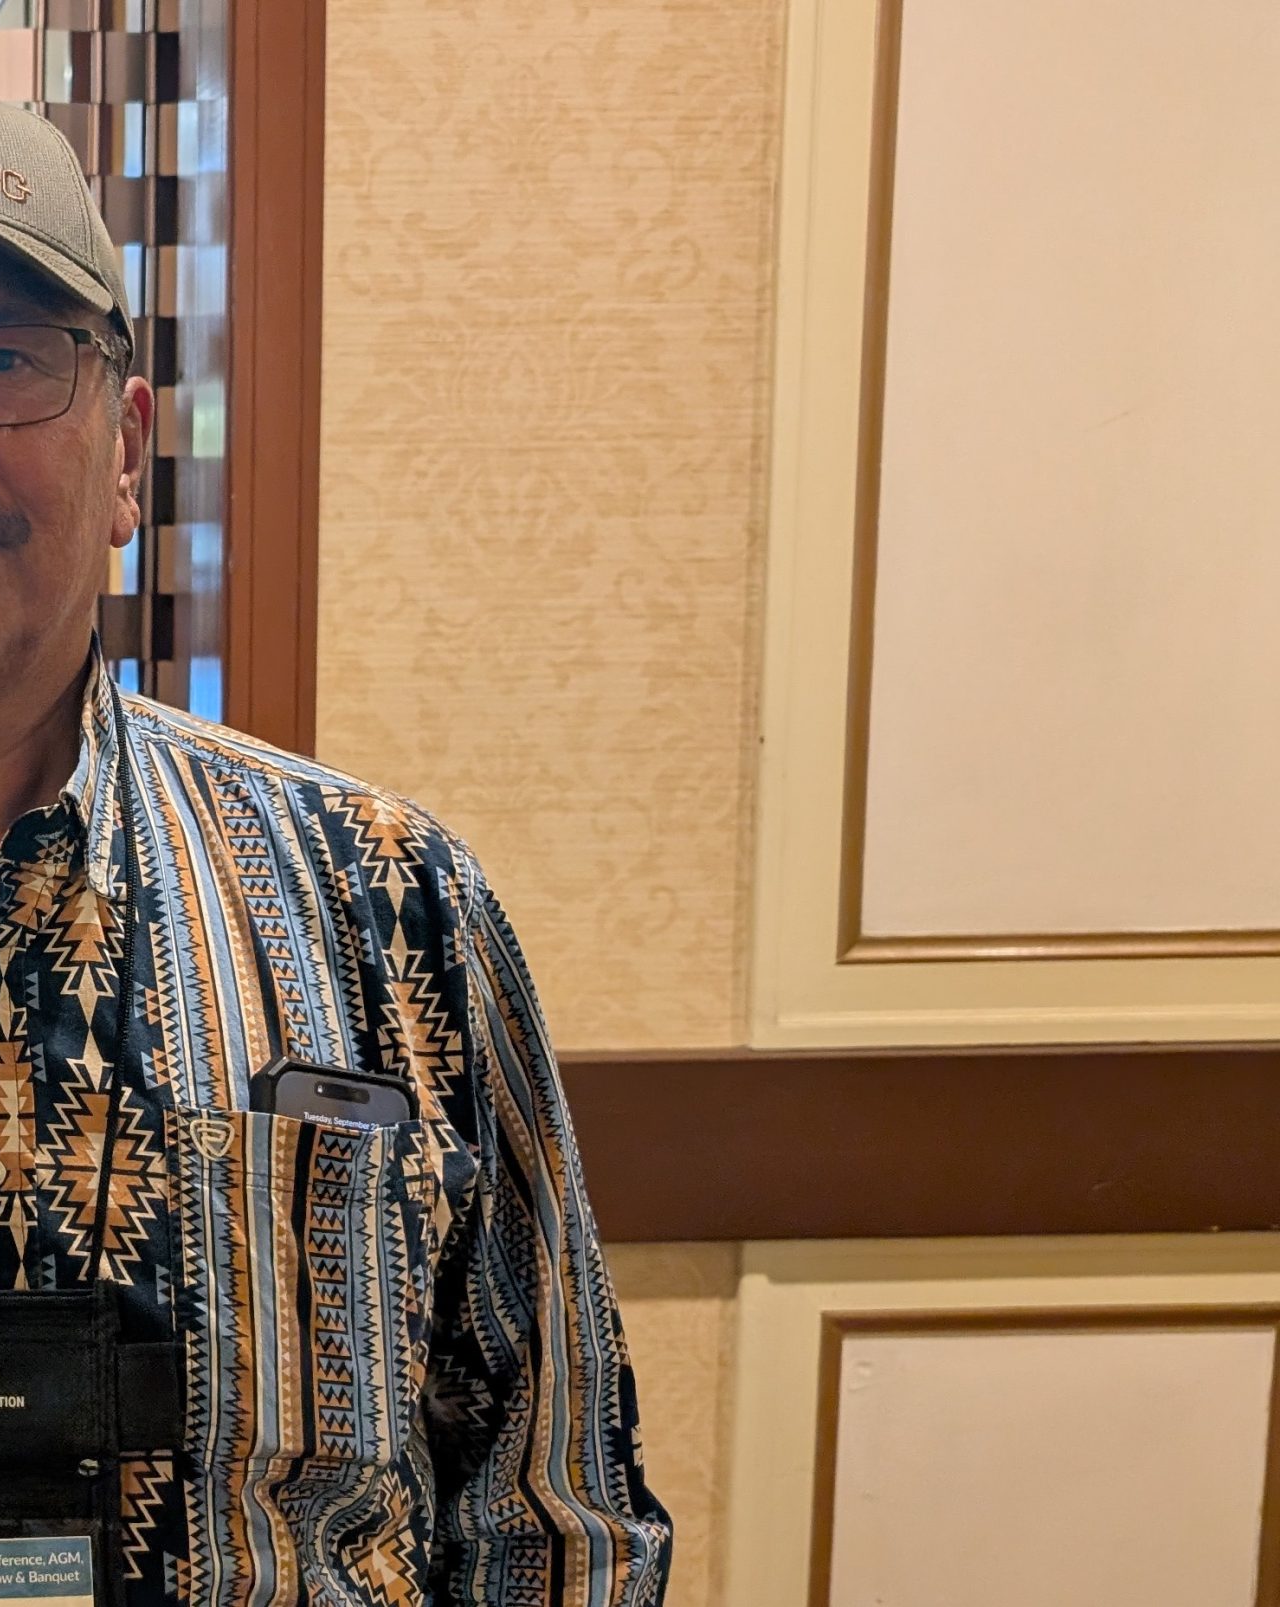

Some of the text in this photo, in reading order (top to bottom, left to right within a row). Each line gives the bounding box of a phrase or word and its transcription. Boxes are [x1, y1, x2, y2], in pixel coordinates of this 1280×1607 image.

[333, 1117, 370, 1129] September
[15, 1571, 26, 1584] &
[29, 1570, 80, 1585] Banquet
